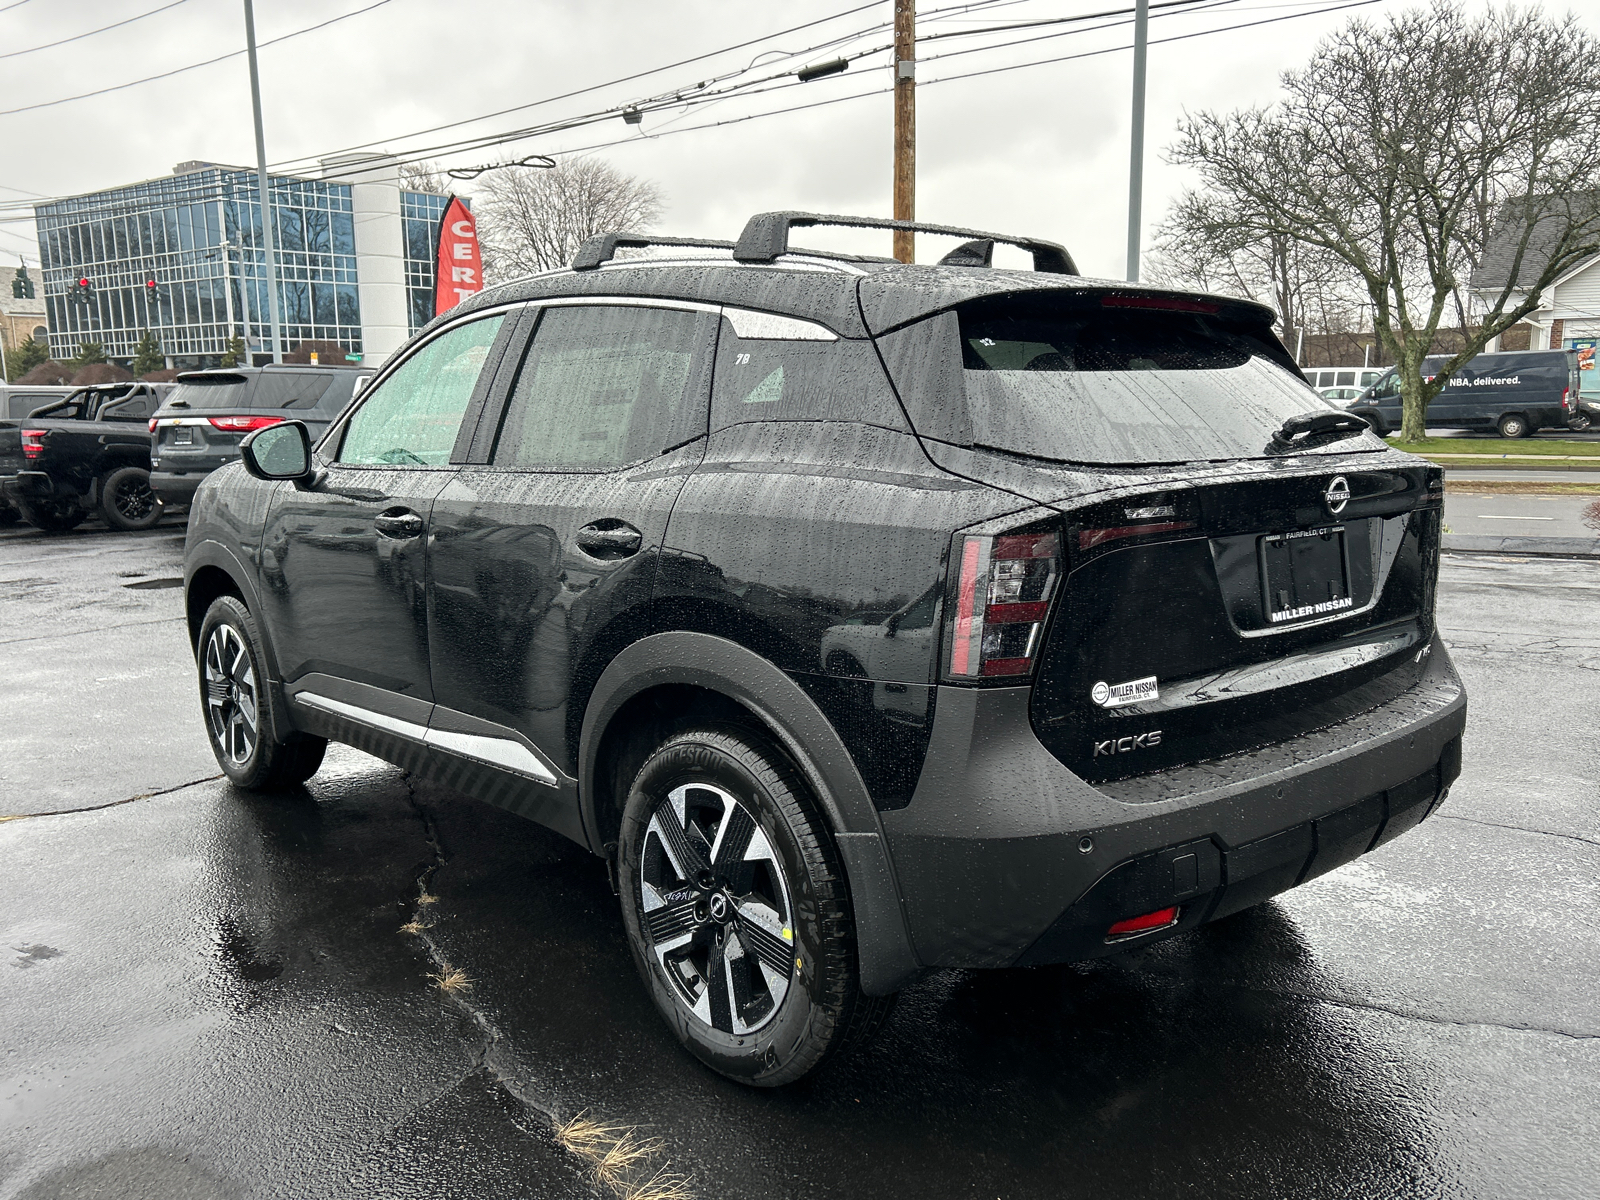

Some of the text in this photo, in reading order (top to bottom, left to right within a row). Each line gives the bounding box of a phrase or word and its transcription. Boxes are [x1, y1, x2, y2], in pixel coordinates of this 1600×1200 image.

[1449, 376, 1521, 387] NBA, delivered.
[1327, 491, 1350, 500] NISSAN
[1286, 530, 1318, 539] FAIRFIELD,
[1272, 598, 1353, 622] MILLER NISSAN
[1110, 681, 1157, 698] MILLER NISSAN
[1093, 730, 1162, 757] KICKS
